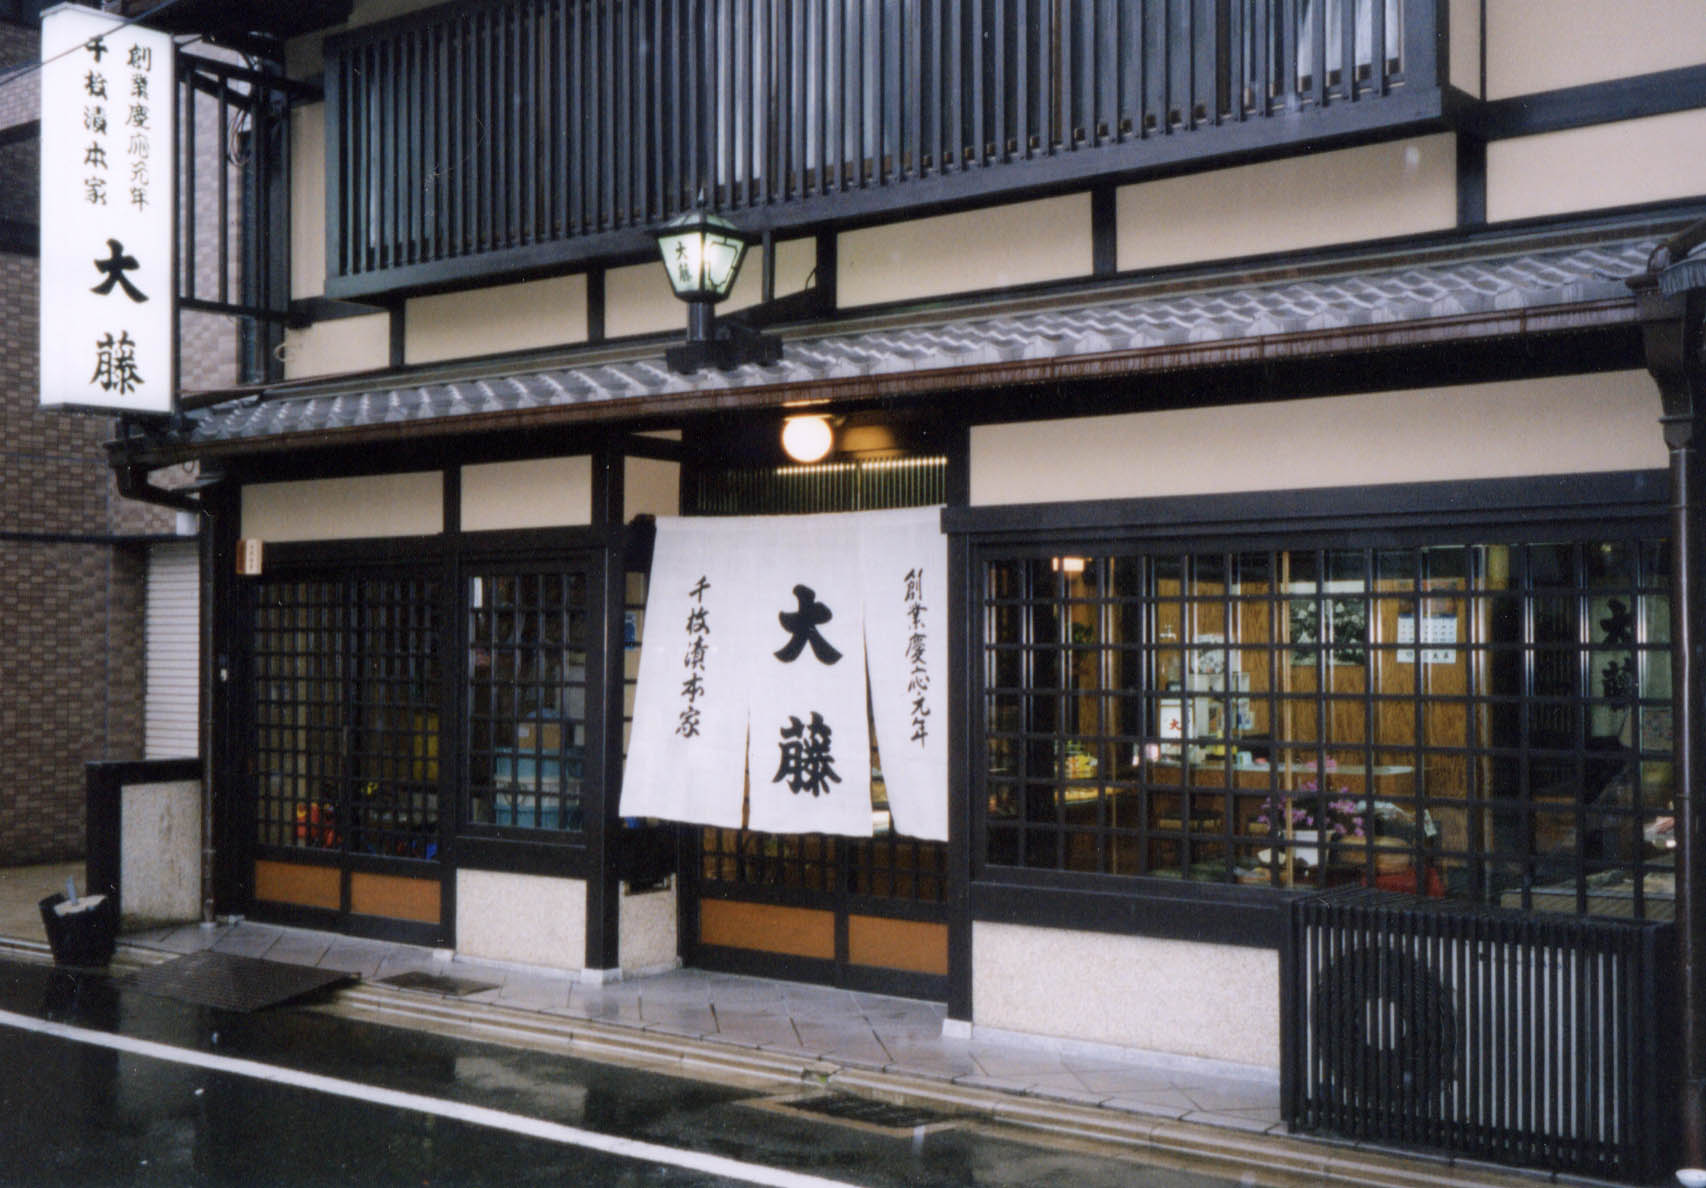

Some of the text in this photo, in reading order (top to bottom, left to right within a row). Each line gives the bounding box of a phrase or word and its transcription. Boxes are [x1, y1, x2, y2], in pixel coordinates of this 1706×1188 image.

[83, 37, 108, 206] 千枚漬本家
[90, 238, 149, 396] 大藤
[675, 575, 711, 739] 千枚漬本家
[772, 584, 843, 798] 大藤
